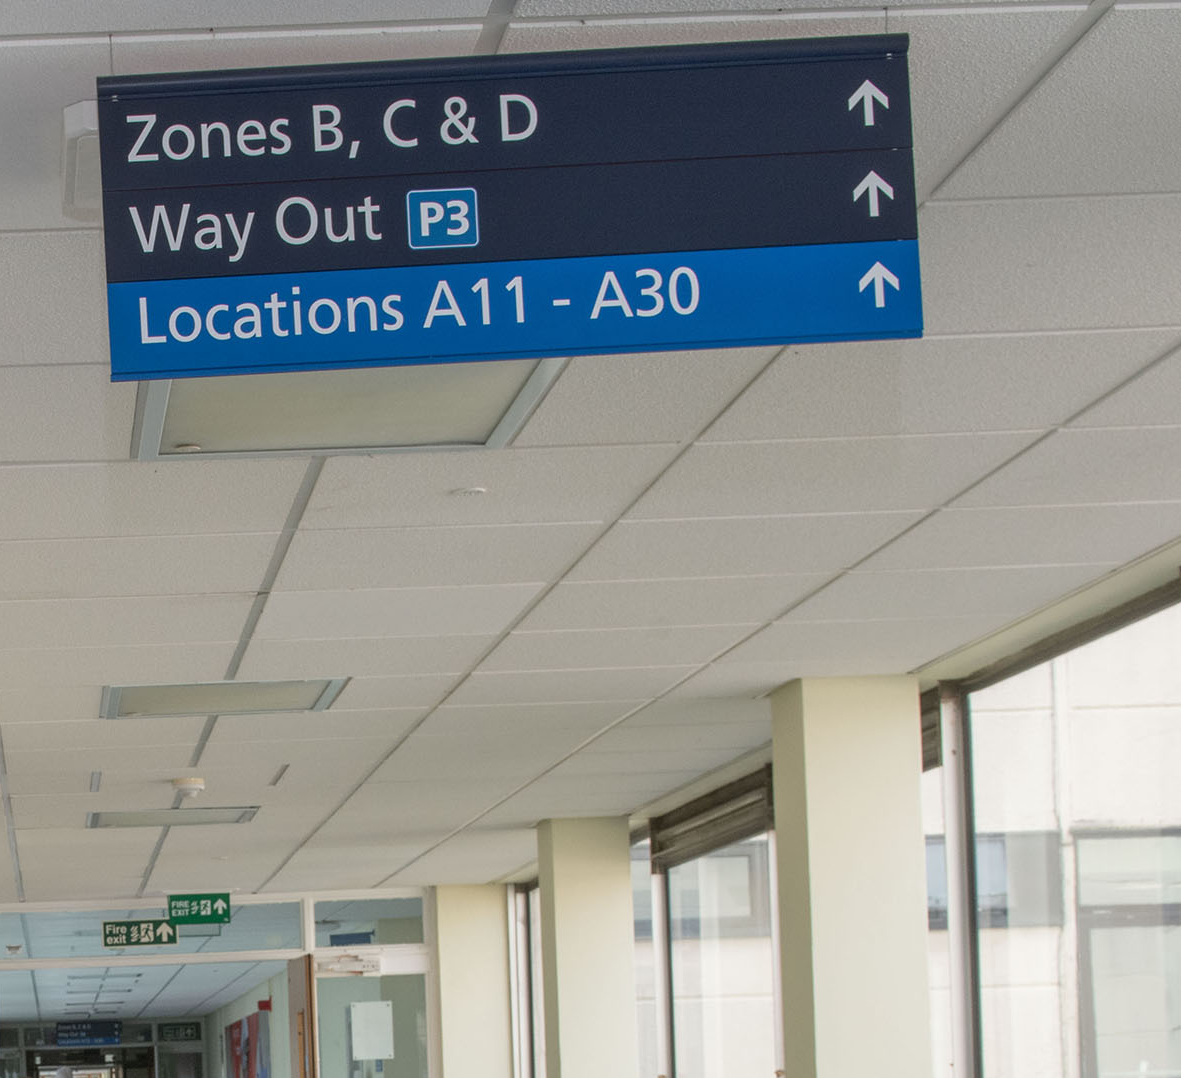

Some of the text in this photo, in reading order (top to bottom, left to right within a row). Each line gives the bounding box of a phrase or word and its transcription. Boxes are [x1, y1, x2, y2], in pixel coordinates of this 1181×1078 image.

[126, 93, 538, 163] Zones B, C & D
[128, 195, 470, 263] Way Out P3
[138, 266, 700, 345] Locations A11 - A30
[171, 900, 190, 909] FIRE
[171, 908, 190, 917] EXIT
[105, 924, 128, 935] Fire
[106, 935, 128, 945] exit
